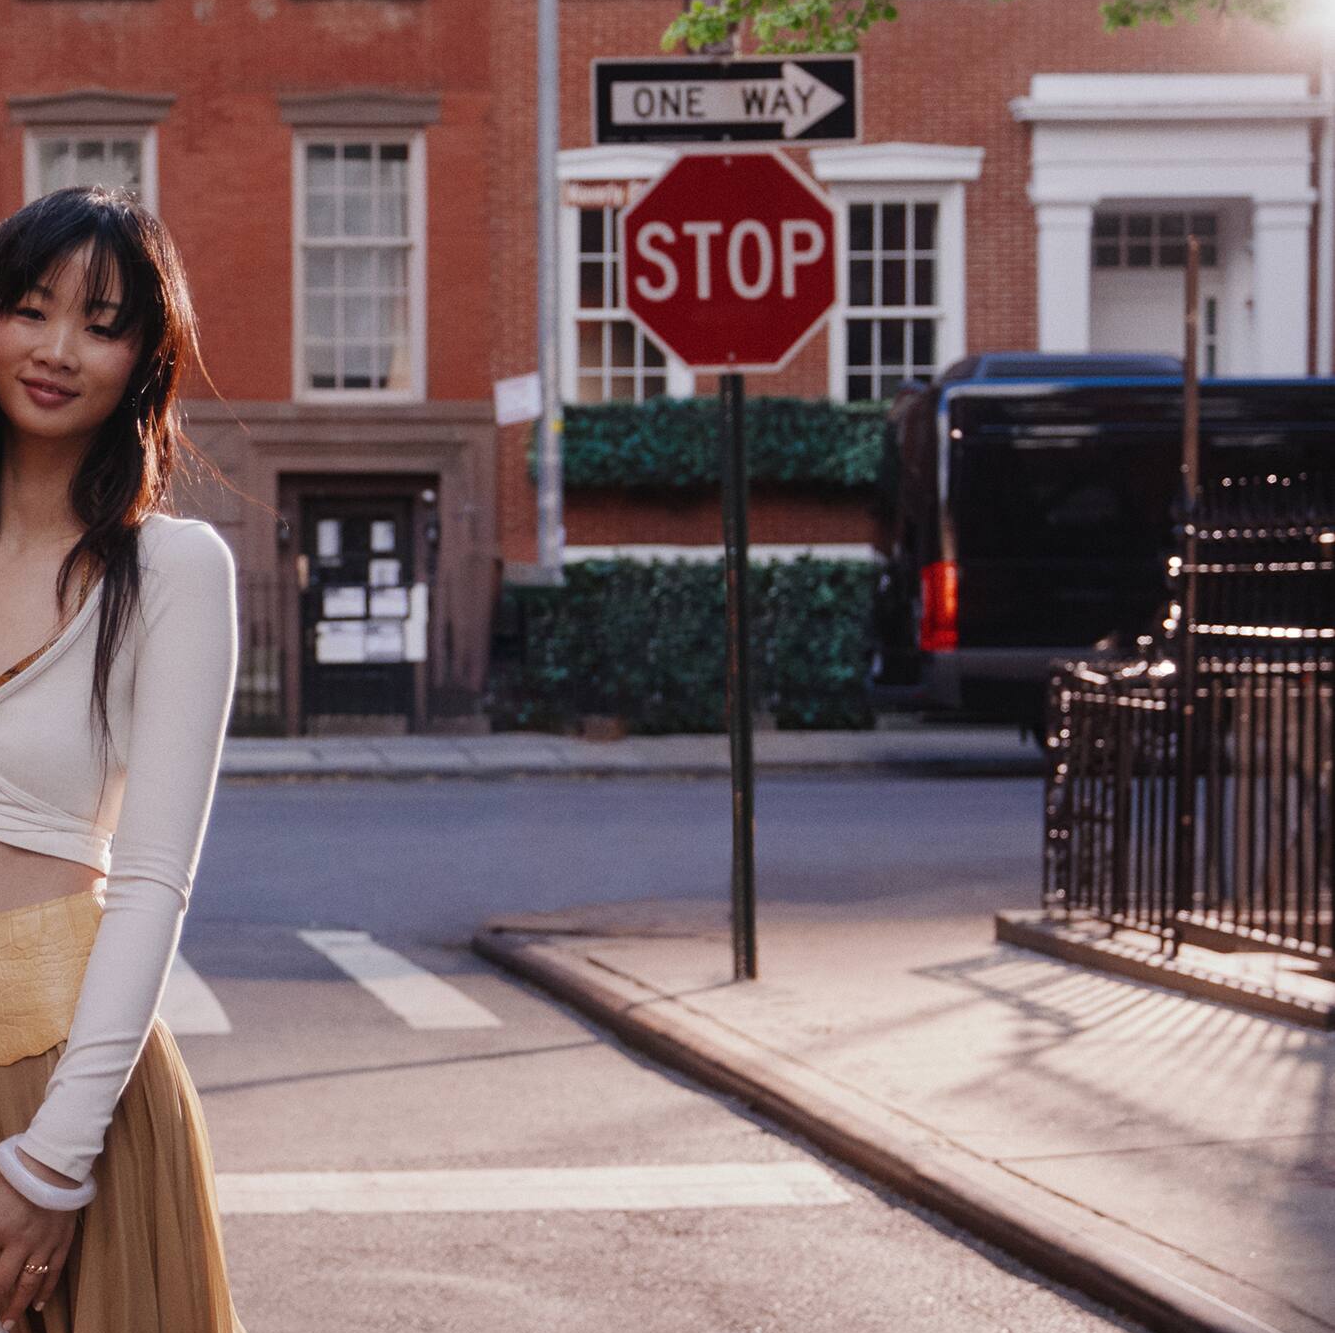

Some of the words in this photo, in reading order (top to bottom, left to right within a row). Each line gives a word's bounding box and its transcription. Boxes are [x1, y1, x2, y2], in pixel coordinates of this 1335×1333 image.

[632, 86, 706, 118] ONE
[741, 84, 817, 117] WAY
[634, 218, 826, 303] STOP
